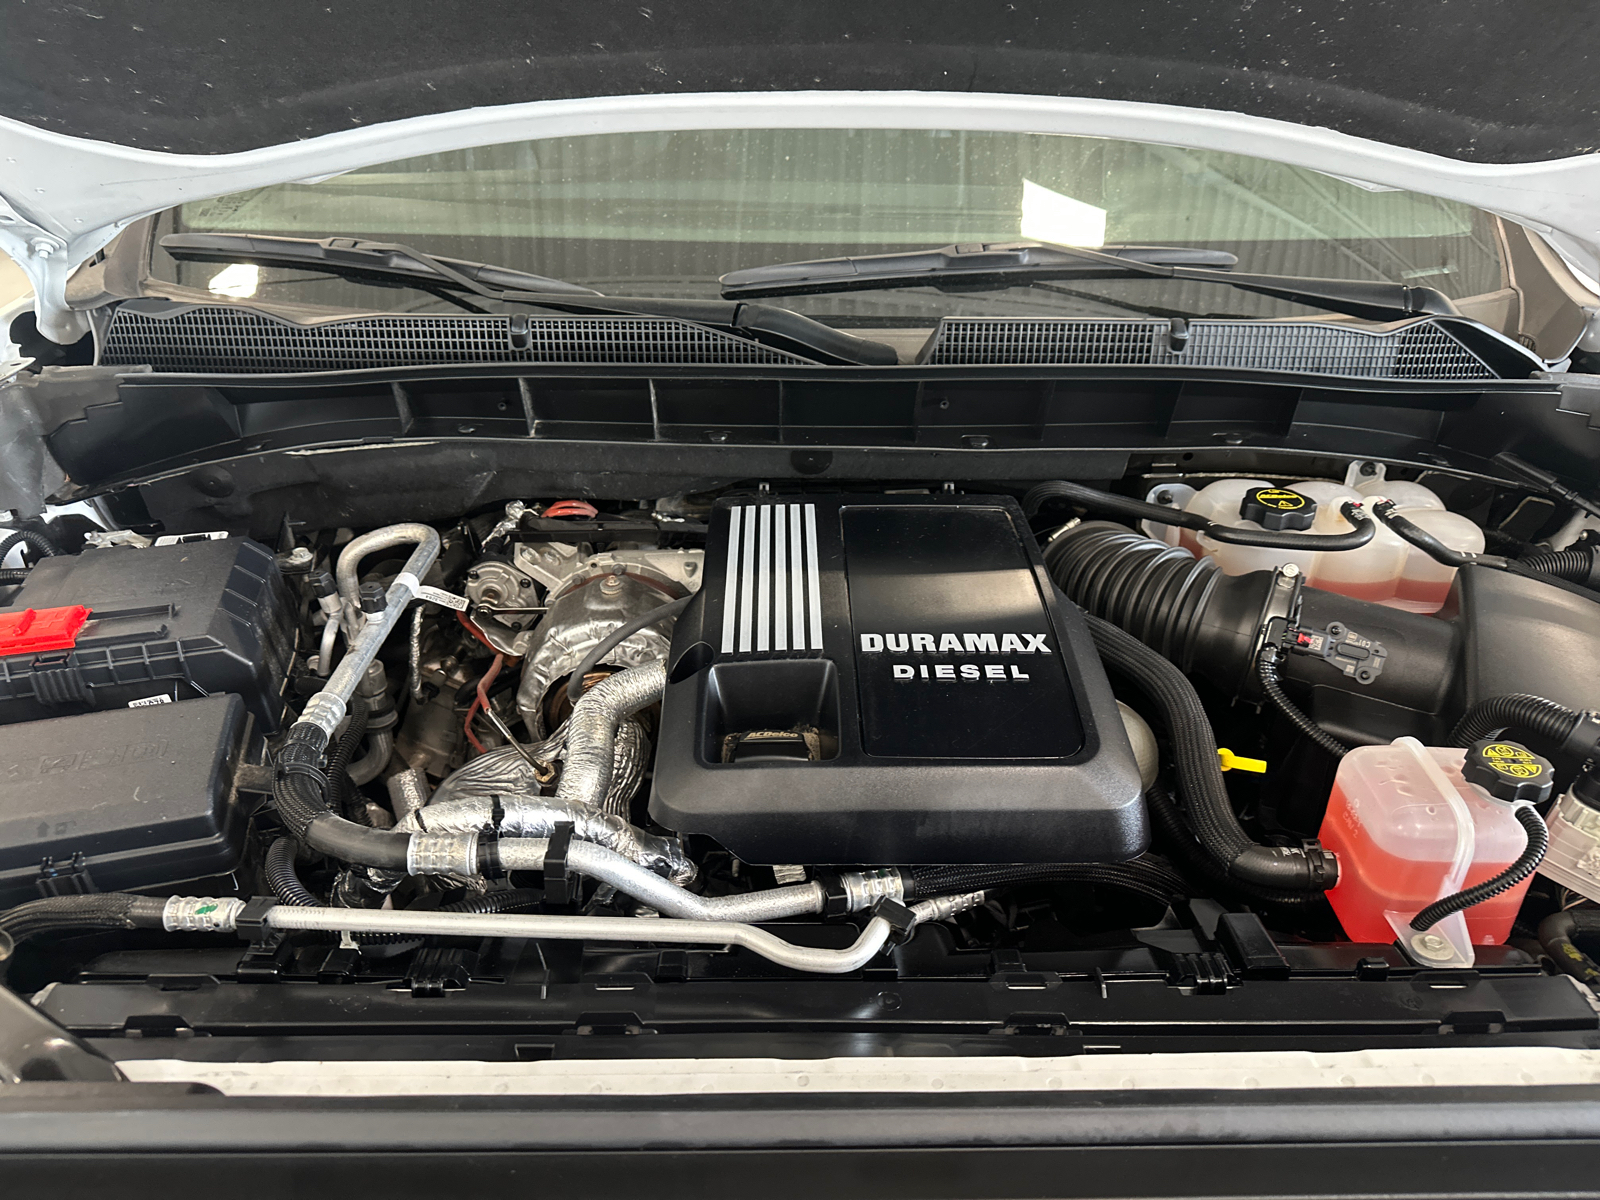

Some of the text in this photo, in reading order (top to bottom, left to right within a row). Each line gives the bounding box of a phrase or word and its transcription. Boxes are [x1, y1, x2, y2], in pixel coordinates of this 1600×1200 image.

[860, 633, 1052, 653] DURAMAX
[893, 664, 1030, 680] DIESEL
[744, 731, 799, 740] ACDelco
